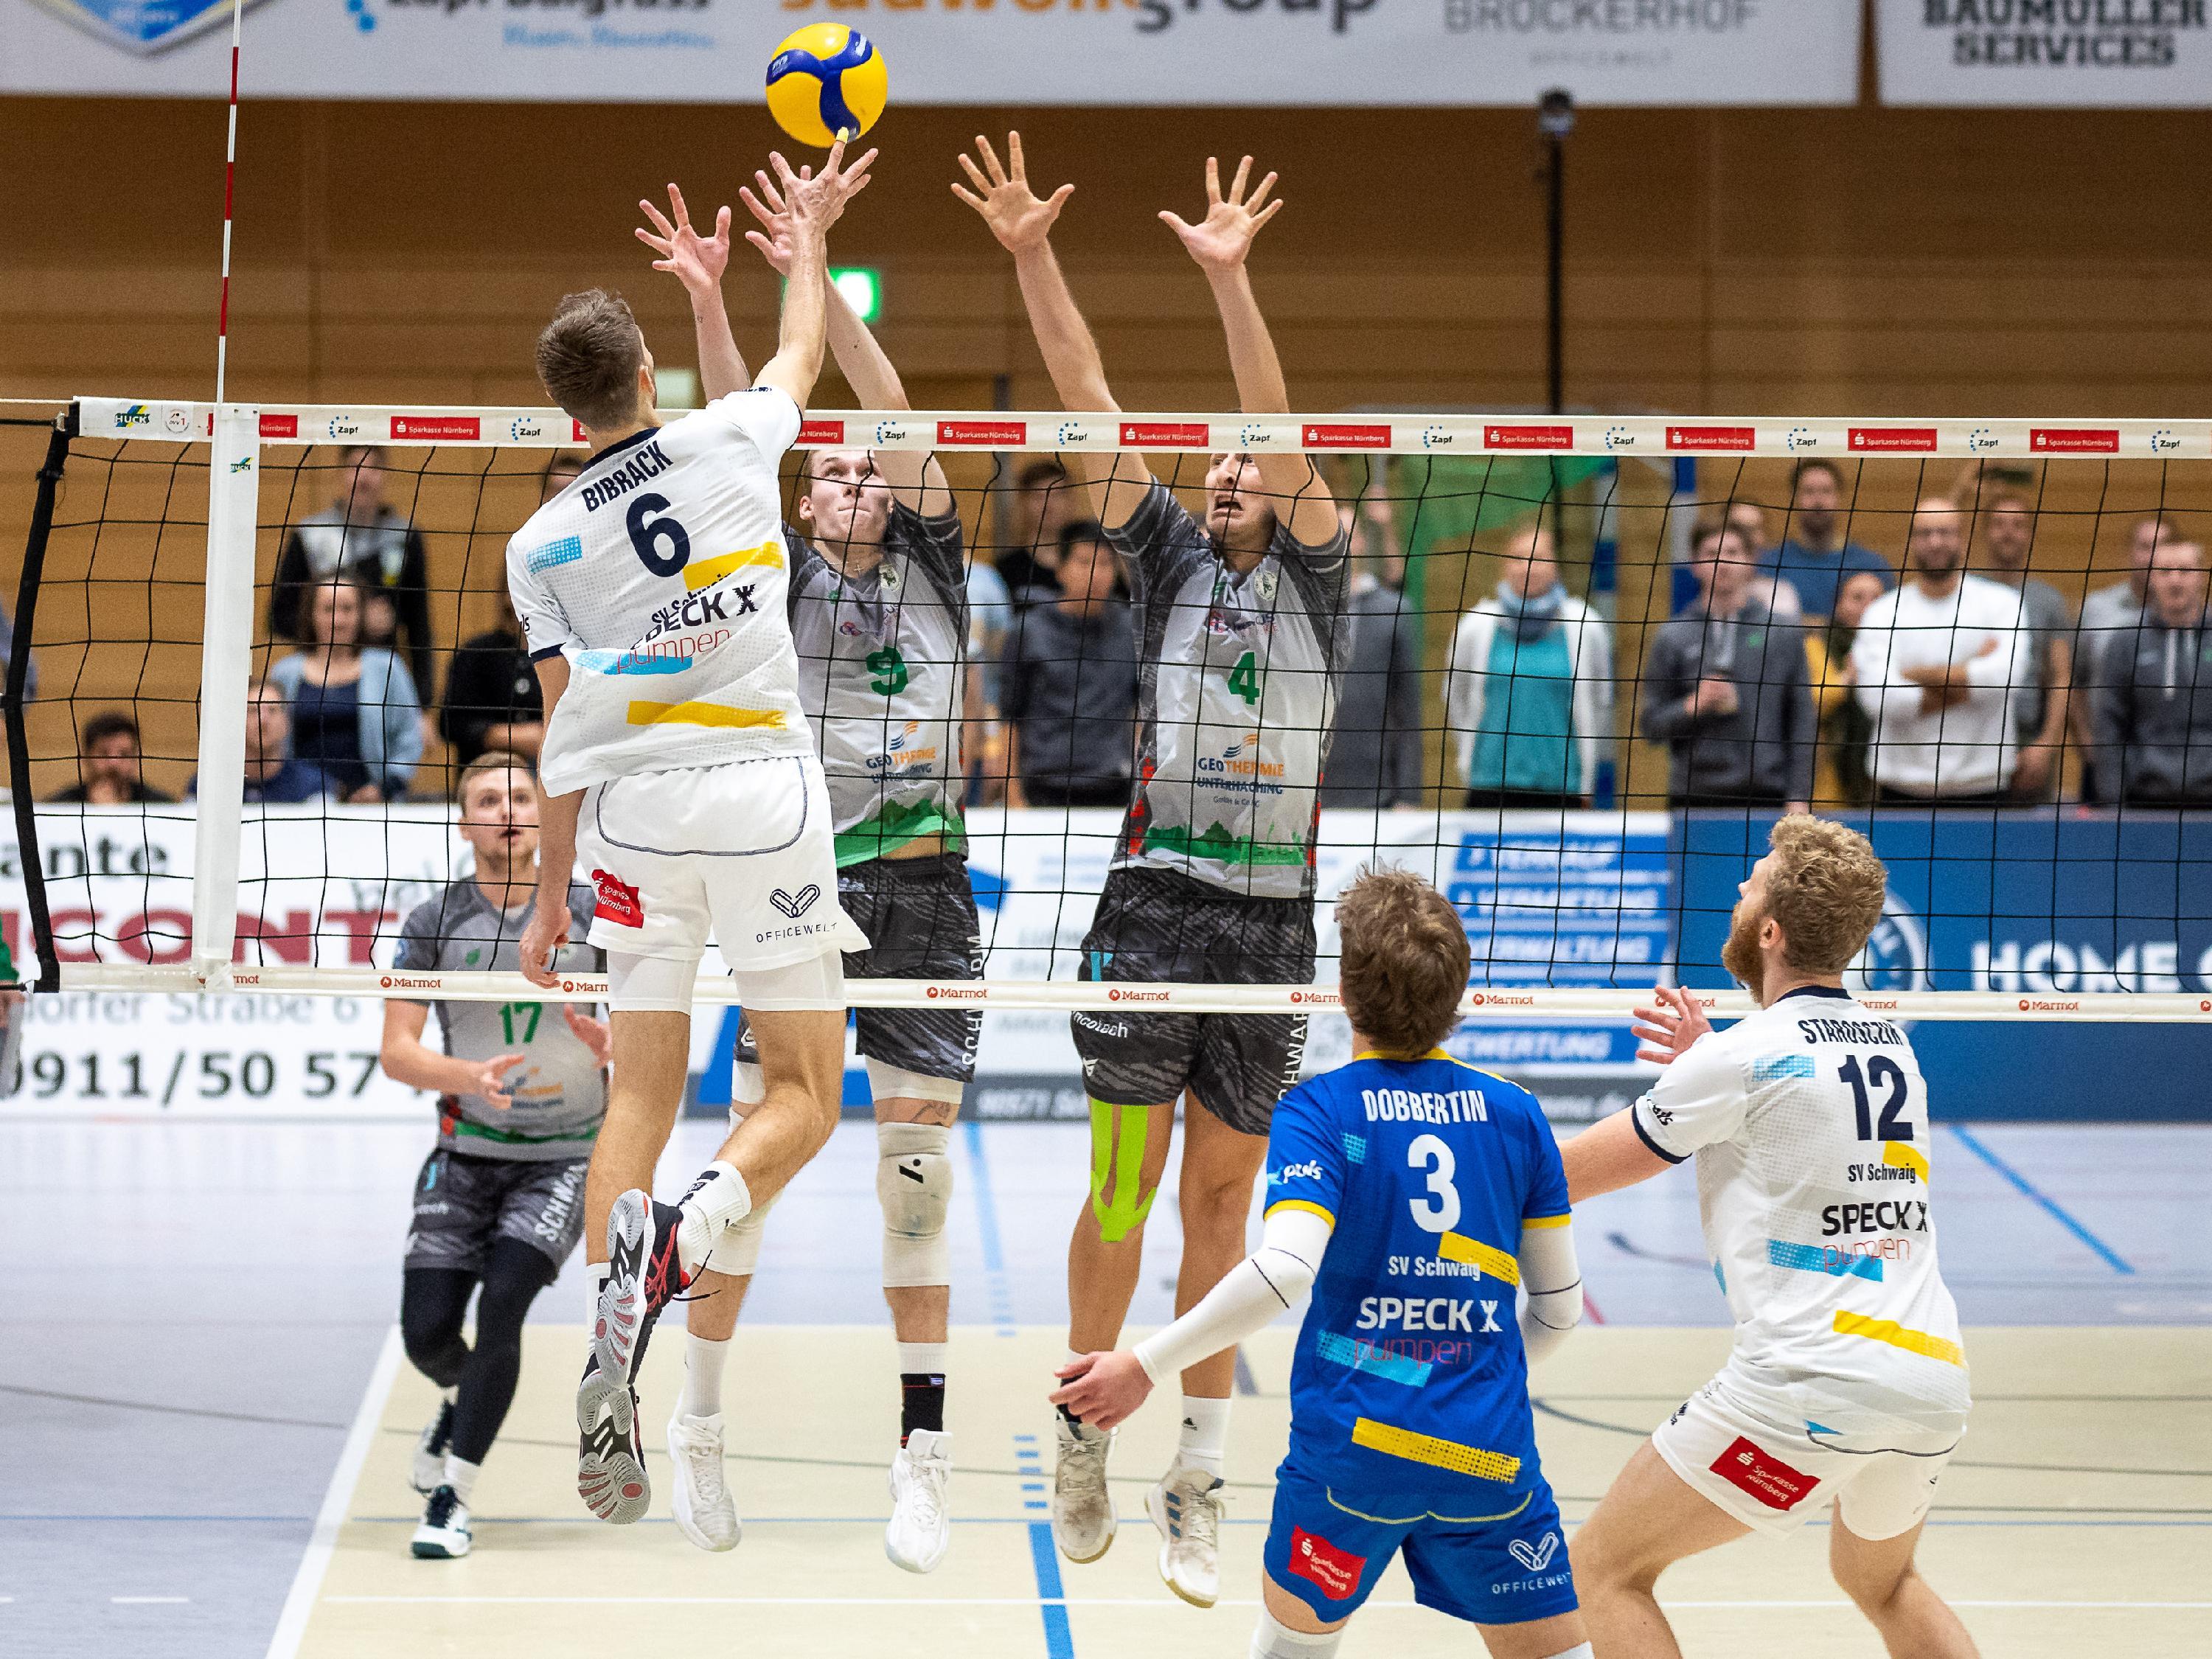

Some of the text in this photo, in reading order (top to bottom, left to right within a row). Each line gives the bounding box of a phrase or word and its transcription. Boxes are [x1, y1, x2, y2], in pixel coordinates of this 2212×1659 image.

[338, 426, 358, 434] Zapf
[408, 426, 473, 436] Sparkasse Nürnberg
[520, 428, 541, 437] Zapf
[807, 431, 838, 439] Nürnberg
[885, 431, 905, 440] Zapf
[956, 431, 1020, 440] Sparkasse Nürnberg
[1067, 433, 1088, 442] Zapf
[1138, 434, 1171, 442] Sparkasse
[1250, 434, 1270, 442] Zapf
[1321, 434, 1385, 444] Sparkasse Nürnberg
[1432, 436, 1453, 444] Zapf
[1502, 435, 1567, 445] Sparkasse Nürnberg
[1614, 437, 1635, 445] Zapf
[1684, 436, 1749, 446] Sparkasse Nürnberg
[1796, 439, 1817, 447] Zapf
[1867, 437, 1931, 448] Sparkasse Nürnberg
[2049, 438, 2113, 448] Sparkasse Nürnberg
[1978, 439, 1999, 448] Zapf
[2160, 440, 2180, 448] Zapf
[581, 440, 674, 512] BIBRACK
[626, 493, 691, 578] 6
[866, 646, 909, 697] 9
[1227, 651, 1260, 706] 4
[756, 922, 838, 943] OFFICEWELT
[1969, 940, 2178, 992] HOME
[394, 977, 442, 988] Marmot
[940, 988, 988, 999] Marmot
[1122, 990, 1170, 1001] Marmot
[1304, 992, 1340, 1003] Marm
[1486, 995, 1534, 1005] Marmot
[1857, 1000, 1898, 1009] armot
[2032, 1001, 2079, 1012] Marmot
[498, 1001, 543, 1046] 17
[1837, 1054, 1915, 1142] 12
[1361, 1088, 1487, 1124] DOBBERTIN
[1848, 1163, 1916, 1183] SV Schwaig
[1407, 1133, 1461, 1234] 3
[1822, 1201, 1913, 1237] SPECK
[1388, 1255, 1481, 1281] SV Schwaig
[1356, 1296, 1474, 1333] SPECK
[1354, 1338, 1472, 1370] pumpen
